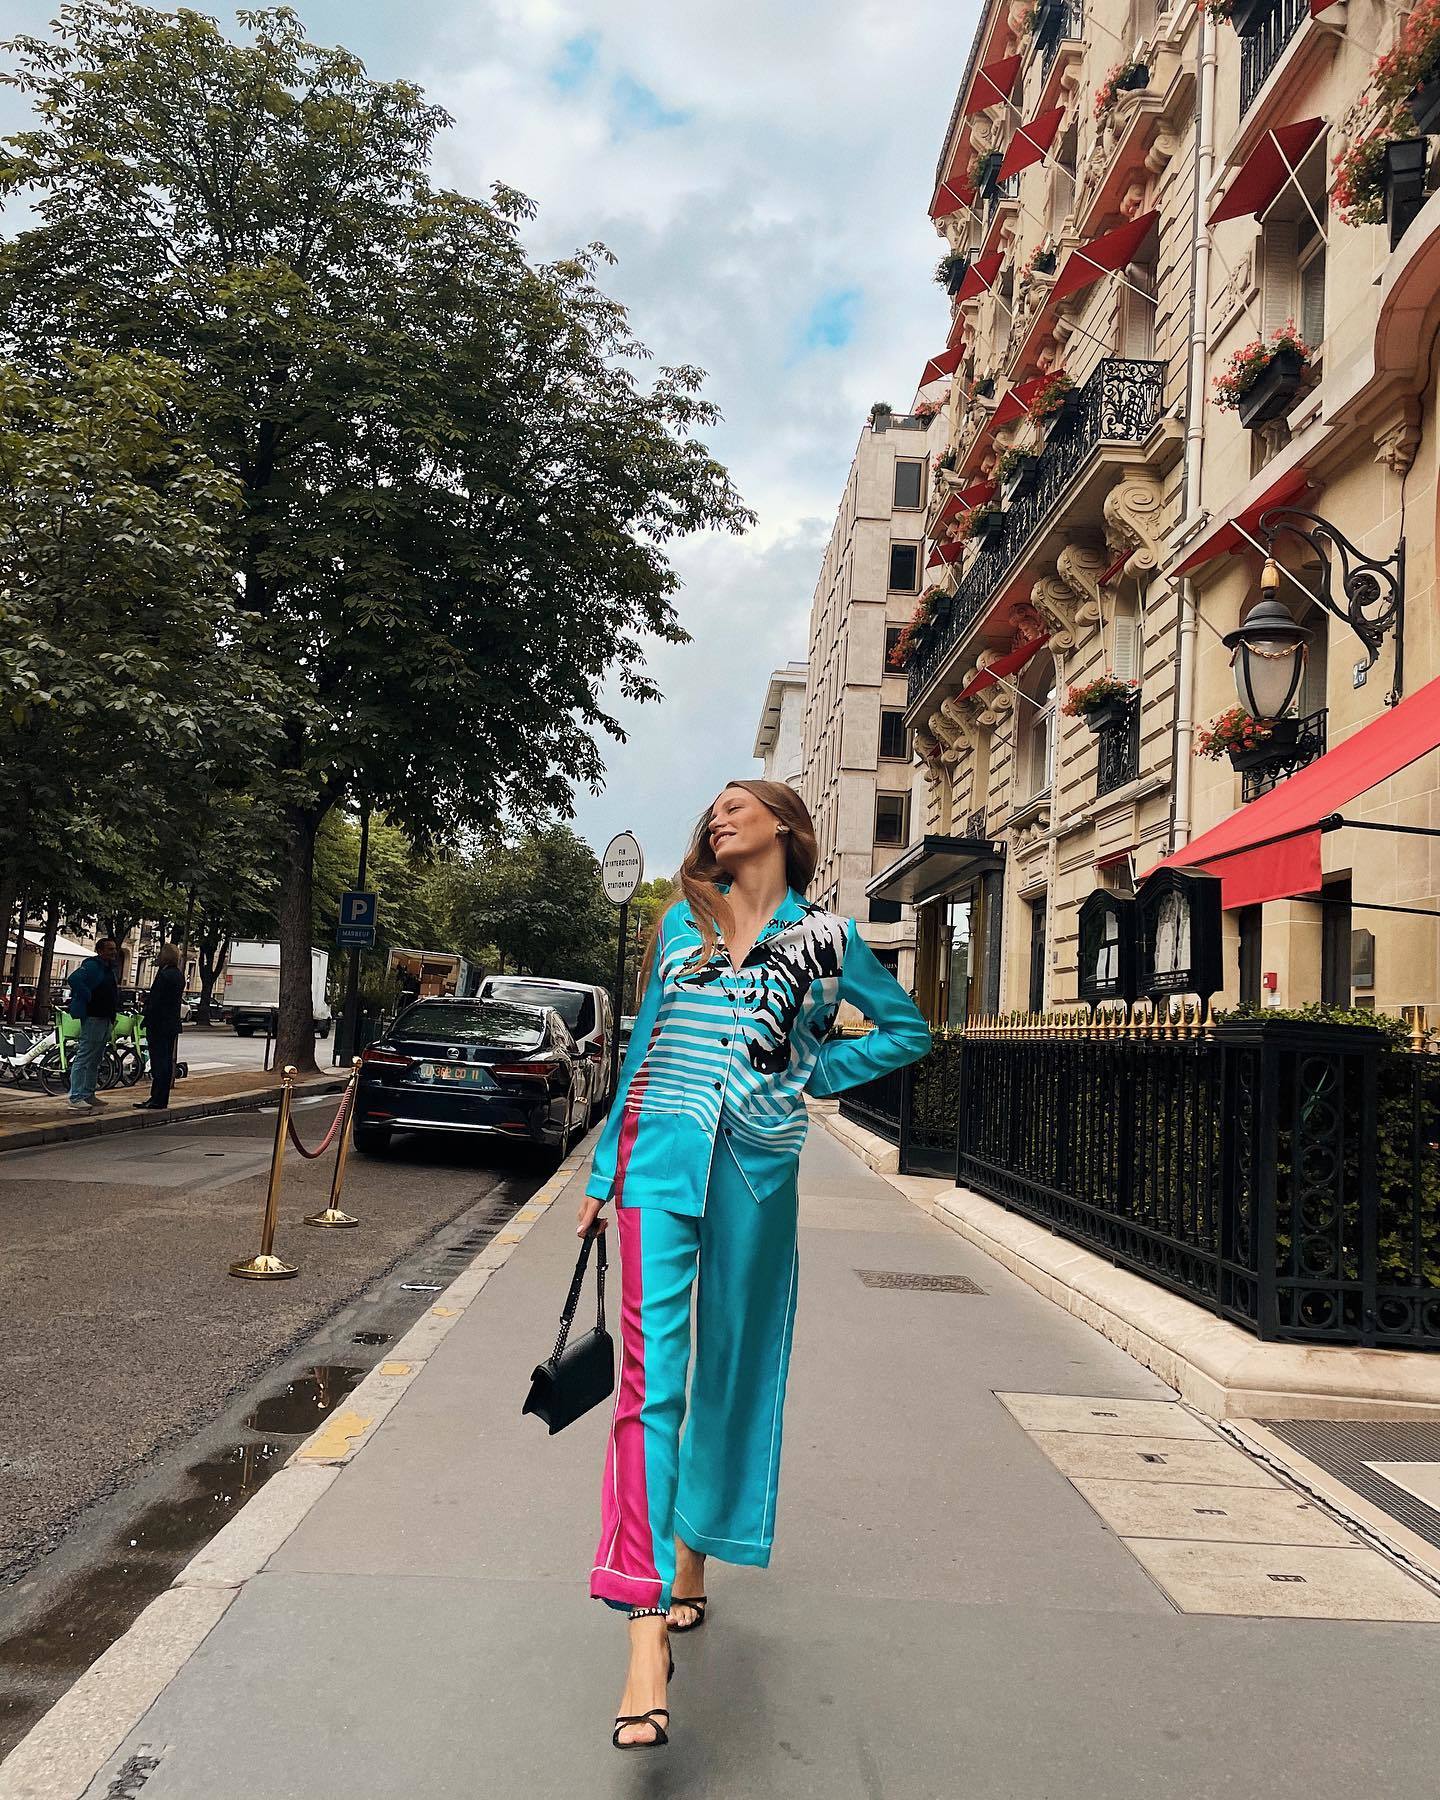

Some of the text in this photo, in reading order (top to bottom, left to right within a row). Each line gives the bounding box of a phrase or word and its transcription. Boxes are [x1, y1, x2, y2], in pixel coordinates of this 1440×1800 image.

[618, 848, 626, 856] FIN
[617, 870, 624, 878] DE
[607, 881, 634, 890] STATIONNER
[351, 899, 368, 921] P
